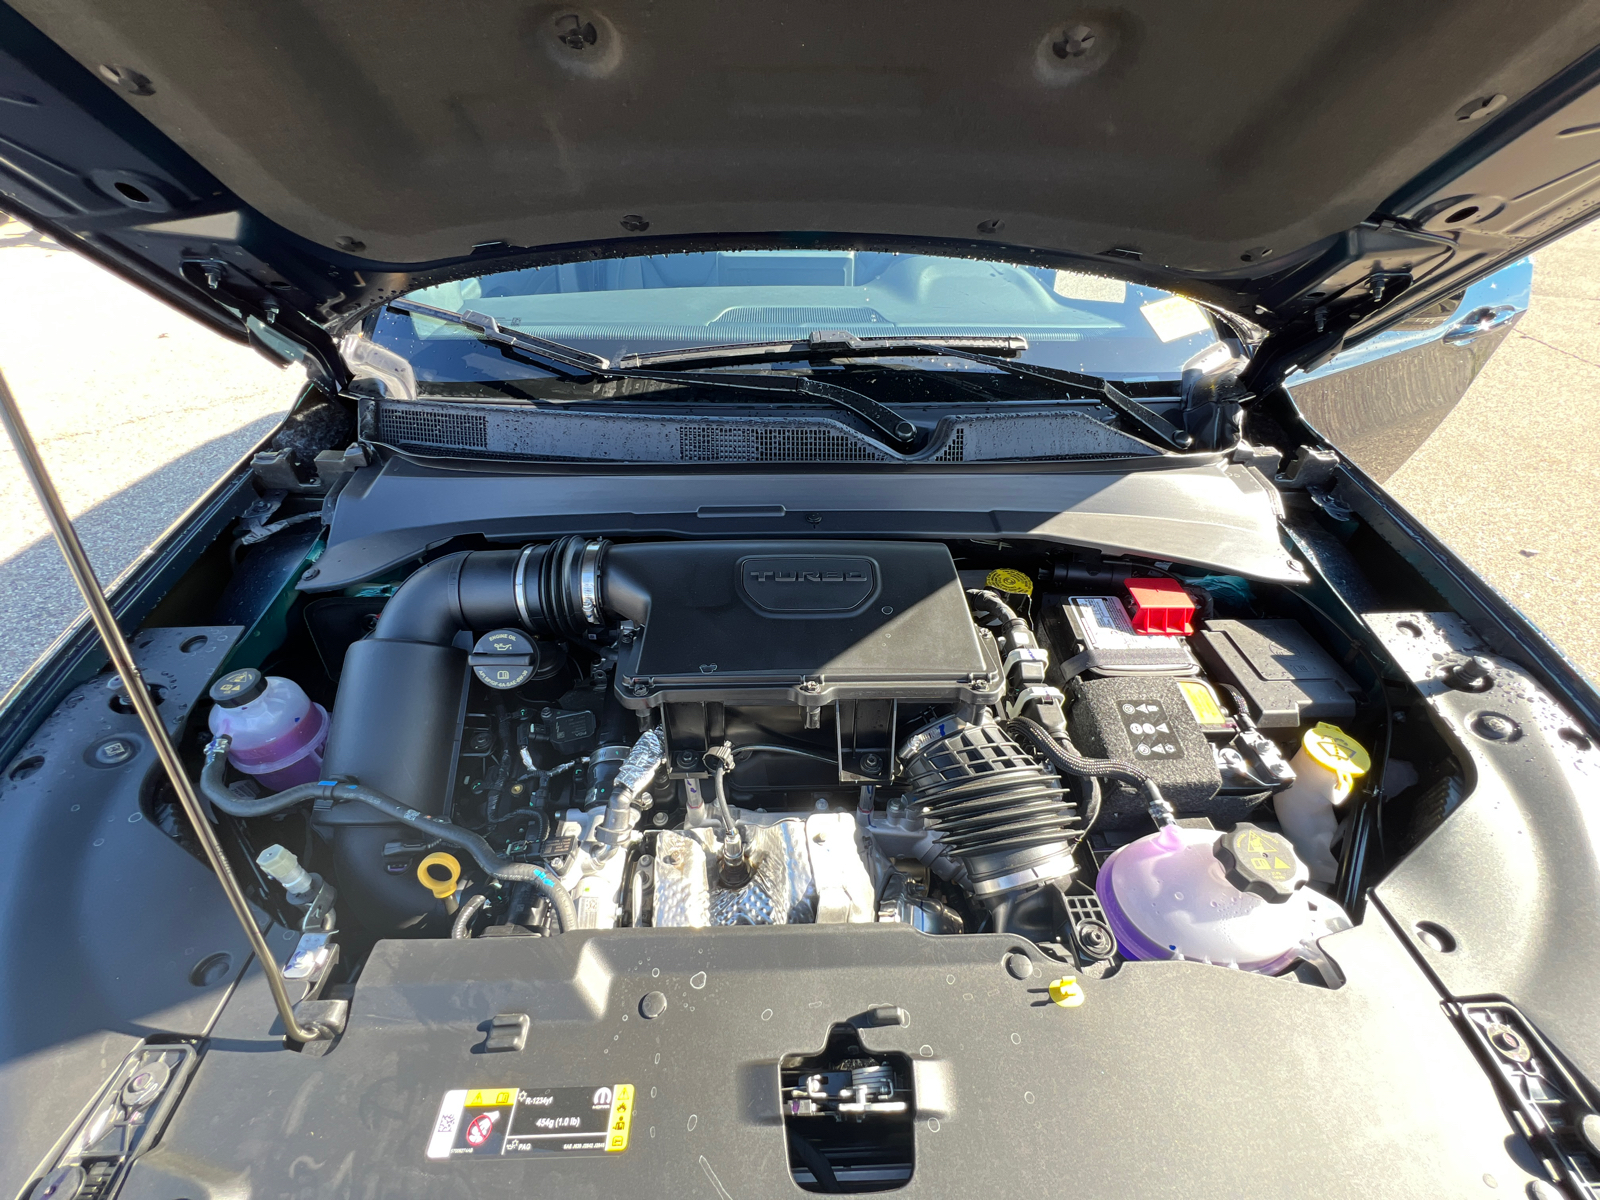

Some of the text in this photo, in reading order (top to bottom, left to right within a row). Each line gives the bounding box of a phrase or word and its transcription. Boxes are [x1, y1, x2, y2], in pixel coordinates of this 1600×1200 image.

[750, 571, 868, 582] TURBO
[489, 634, 517, 642] ENGINE OIL
[525, 1096, 553, 1106] R-1234yf
[536, 1116, 580, 1128] 454g (1.0 lb)
